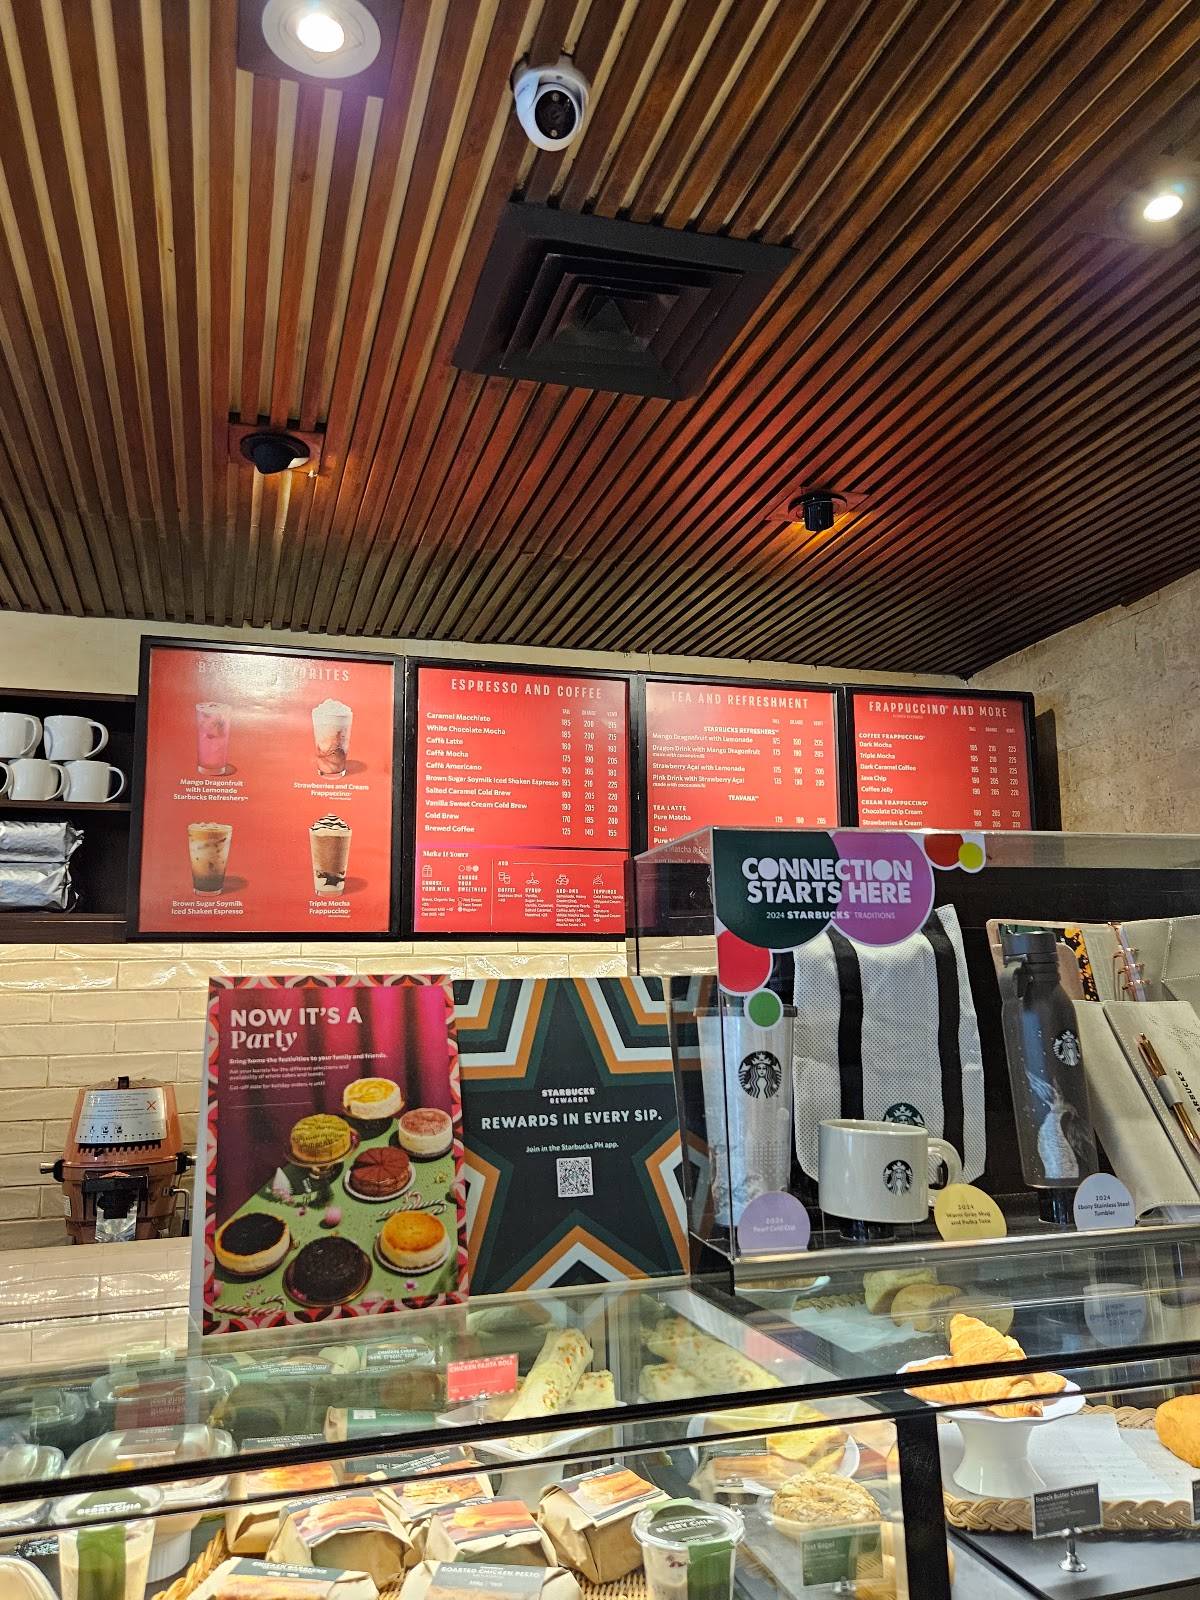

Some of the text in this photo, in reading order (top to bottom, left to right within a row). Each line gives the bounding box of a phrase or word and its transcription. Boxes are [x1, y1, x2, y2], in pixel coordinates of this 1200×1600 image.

[451, 678, 602, 699] ESPRESSO AND COFFEE
[671, 691, 808, 709] TEA AND REFRESHMENT
[952, 705, 974, 716] AND
[979, 706, 1007, 718] MORE
[426, 712, 491, 722] Caramel Macchiato
[427, 724, 506, 735] White Chocolate Mocha
[652, 733, 673, 741] Mango
[652, 744, 674, 752] Dragon
[446, 750, 469, 758] Mocha
[652, 762, 685, 771] Strawberry
[426, 774, 446, 782] Brown
[447, 775, 467, 784] Sugar
[467, 776, 492, 784] Soymilk
[532, 779, 559, 787] Espresso
[698, 776, 731, 784] Strawberry
[426, 787, 447, 795] Salted
[448, 788, 476, 796] Caramel
[494, 789, 511, 797] Brew
[608, 793, 618, 801] 220
[425, 799, 449, 807] Vanilla
[449, 800, 470, 808] Sweet
[471, 801, 493, 809] Cream
[510, 802, 527, 810] Brew
[585, 804, 595, 812] 205
[425, 811, 459, 820] Cold Brew
[425, 824, 475, 833] Brewed Coffee
[741, 857, 913, 882] CONNECTION
[747, 881, 912, 905] STARTS HERE
[766, 910, 895, 920] 2024 STARBUCKS TRADITIONS
[230, 1006, 363, 1027] NOW IT'S A
[230, 1030, 298, 1052] Party
[318, 1055, 332, 1063] your
[333, 1054, 352, 1062] family
[541, 1087, 596, 1097] STARBUCKS
[549, 1096, 589, 1104] REWARDS
[481, 1109, 663, 1130] REWARDS IN EVERY SIP.
[525, 1145, 540, 1153] Join
[549, 1144, 561, 1152] the
[561, 1142, 593, 1151] Starbucks
[594, 1141, 604, 1149] PH
[604, 1142, 619, 1150] app.
[448, 1363, 477, 1373] CHICKEN
[497, 1359, 513, 1367] ROLL
[656, 1519, 714, 1533] BERRY CHIA
[478, 1567, 512, 1576] CHICKEN
